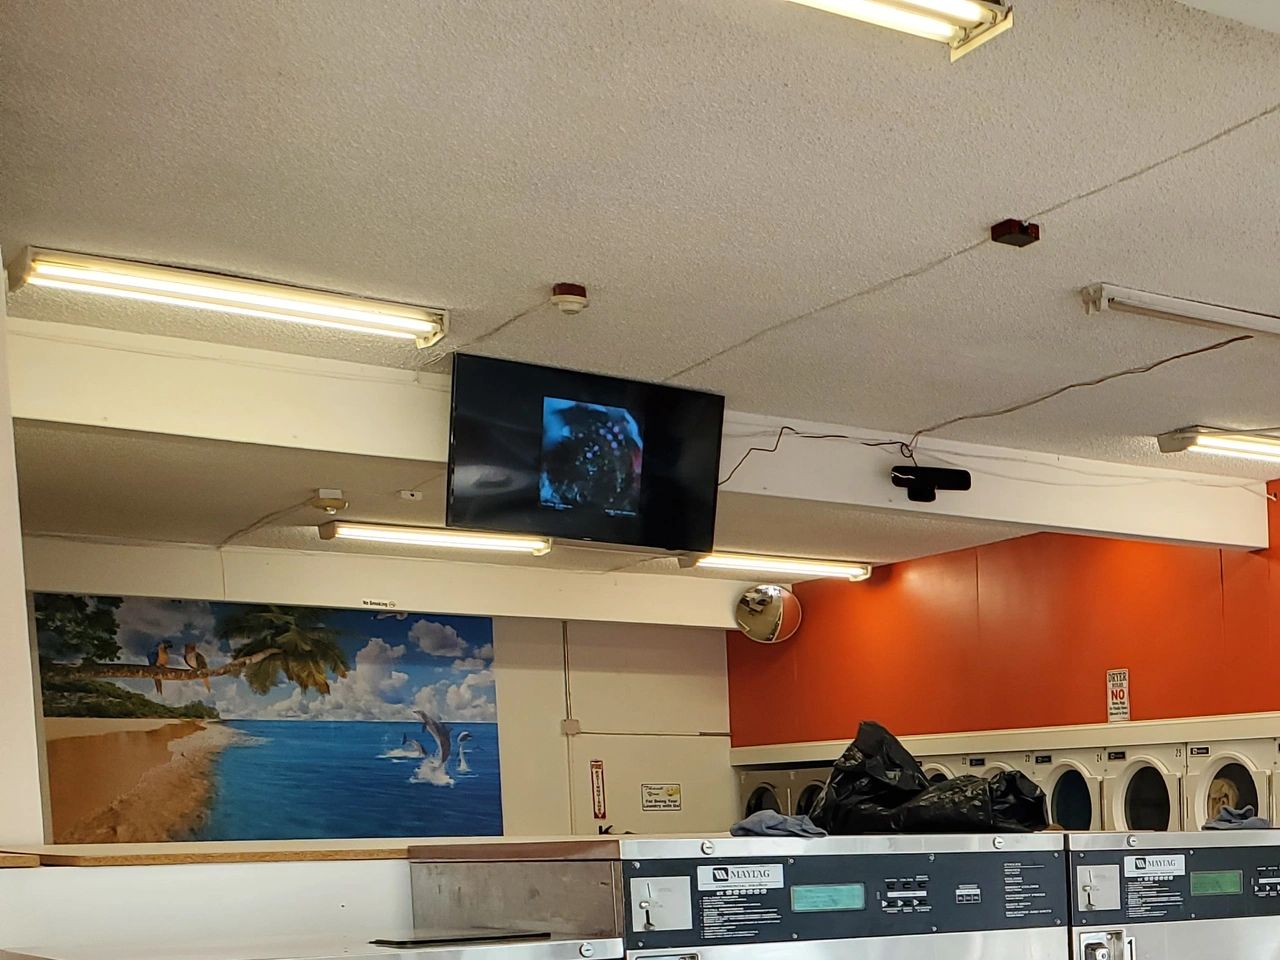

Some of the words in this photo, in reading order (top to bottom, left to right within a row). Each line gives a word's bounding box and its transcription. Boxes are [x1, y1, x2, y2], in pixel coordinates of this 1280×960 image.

[1108, 672, 1127, 682] DRYER
[1111, 689, 1125, 701] NO
[1147, 859, 1176, 867] MAYTAG
[730, 869, 770, 879] MAYTAG
